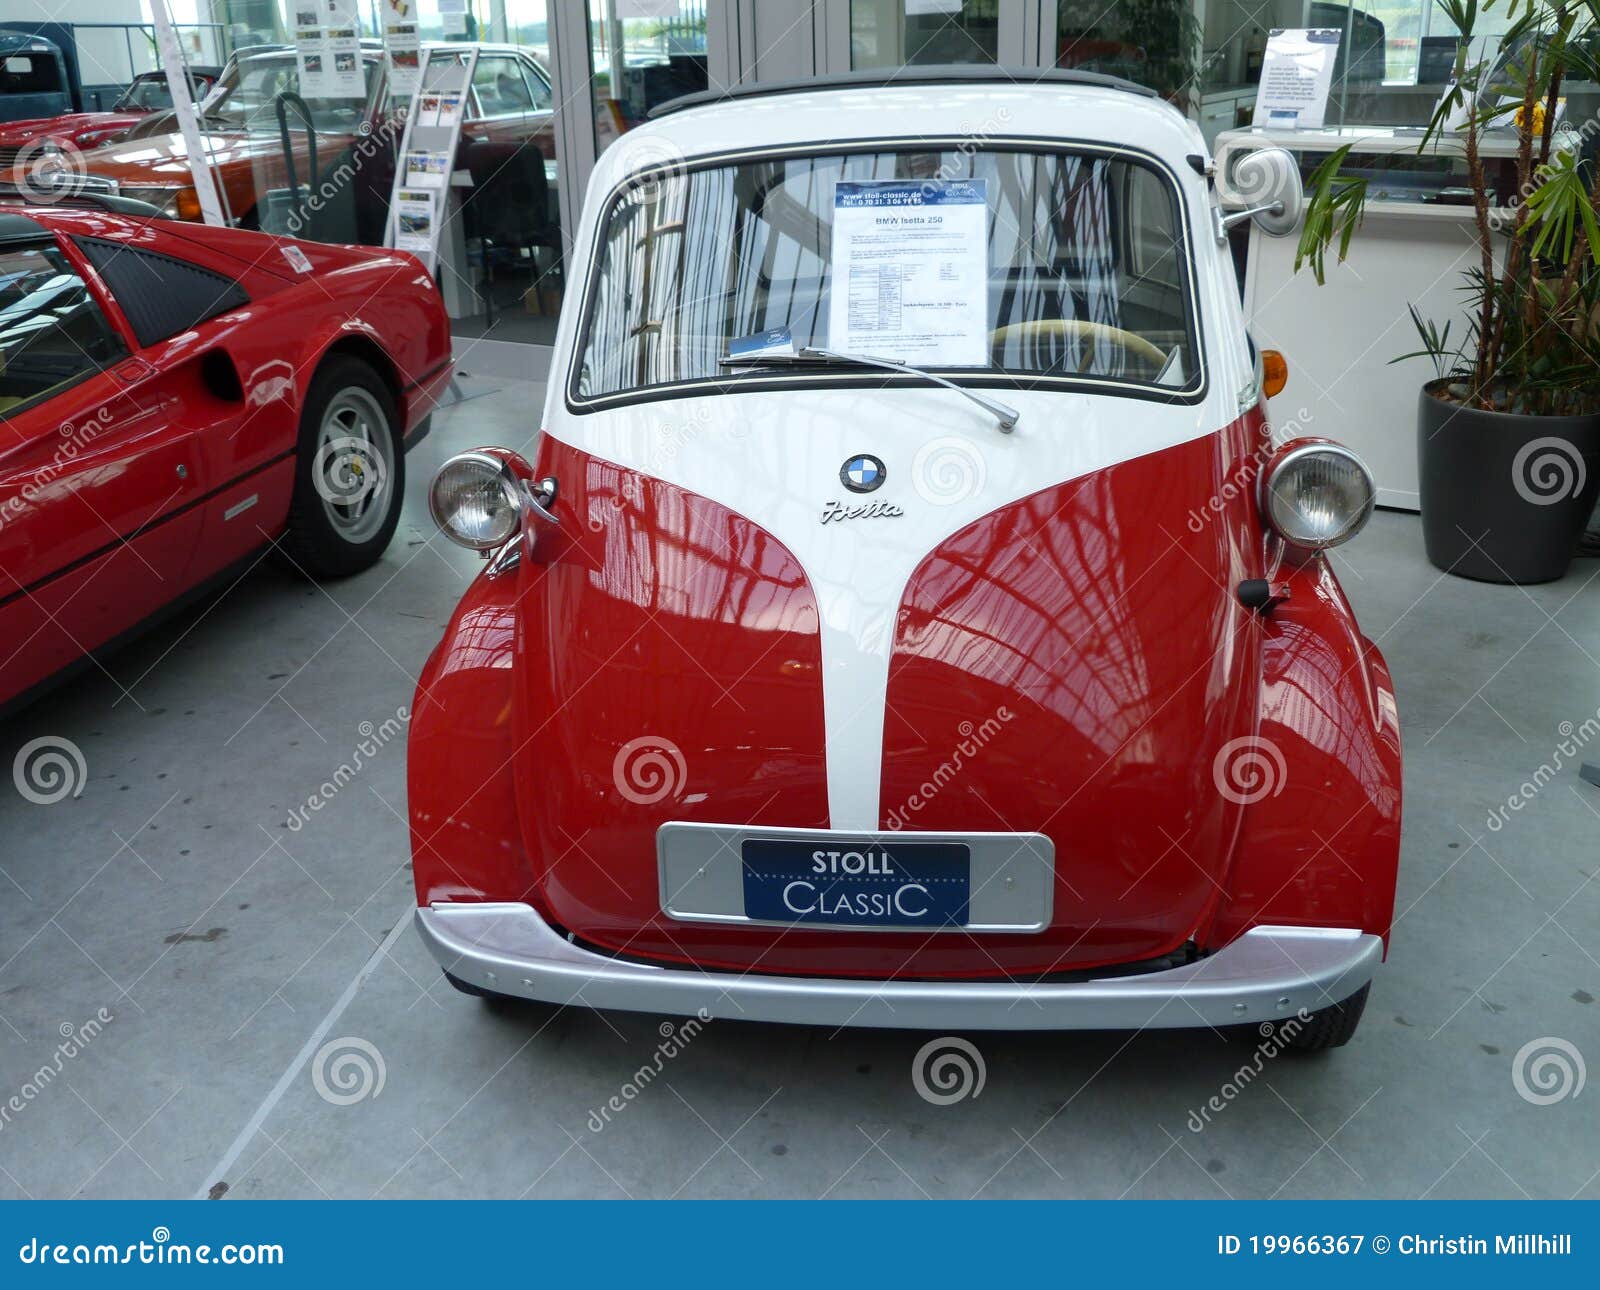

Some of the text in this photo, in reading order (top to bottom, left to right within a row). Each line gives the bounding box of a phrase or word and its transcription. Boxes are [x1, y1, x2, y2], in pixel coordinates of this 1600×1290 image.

[875, 216, 943, 225] BMW Isetta 250
[811, 850, 895, 875] STOLL
